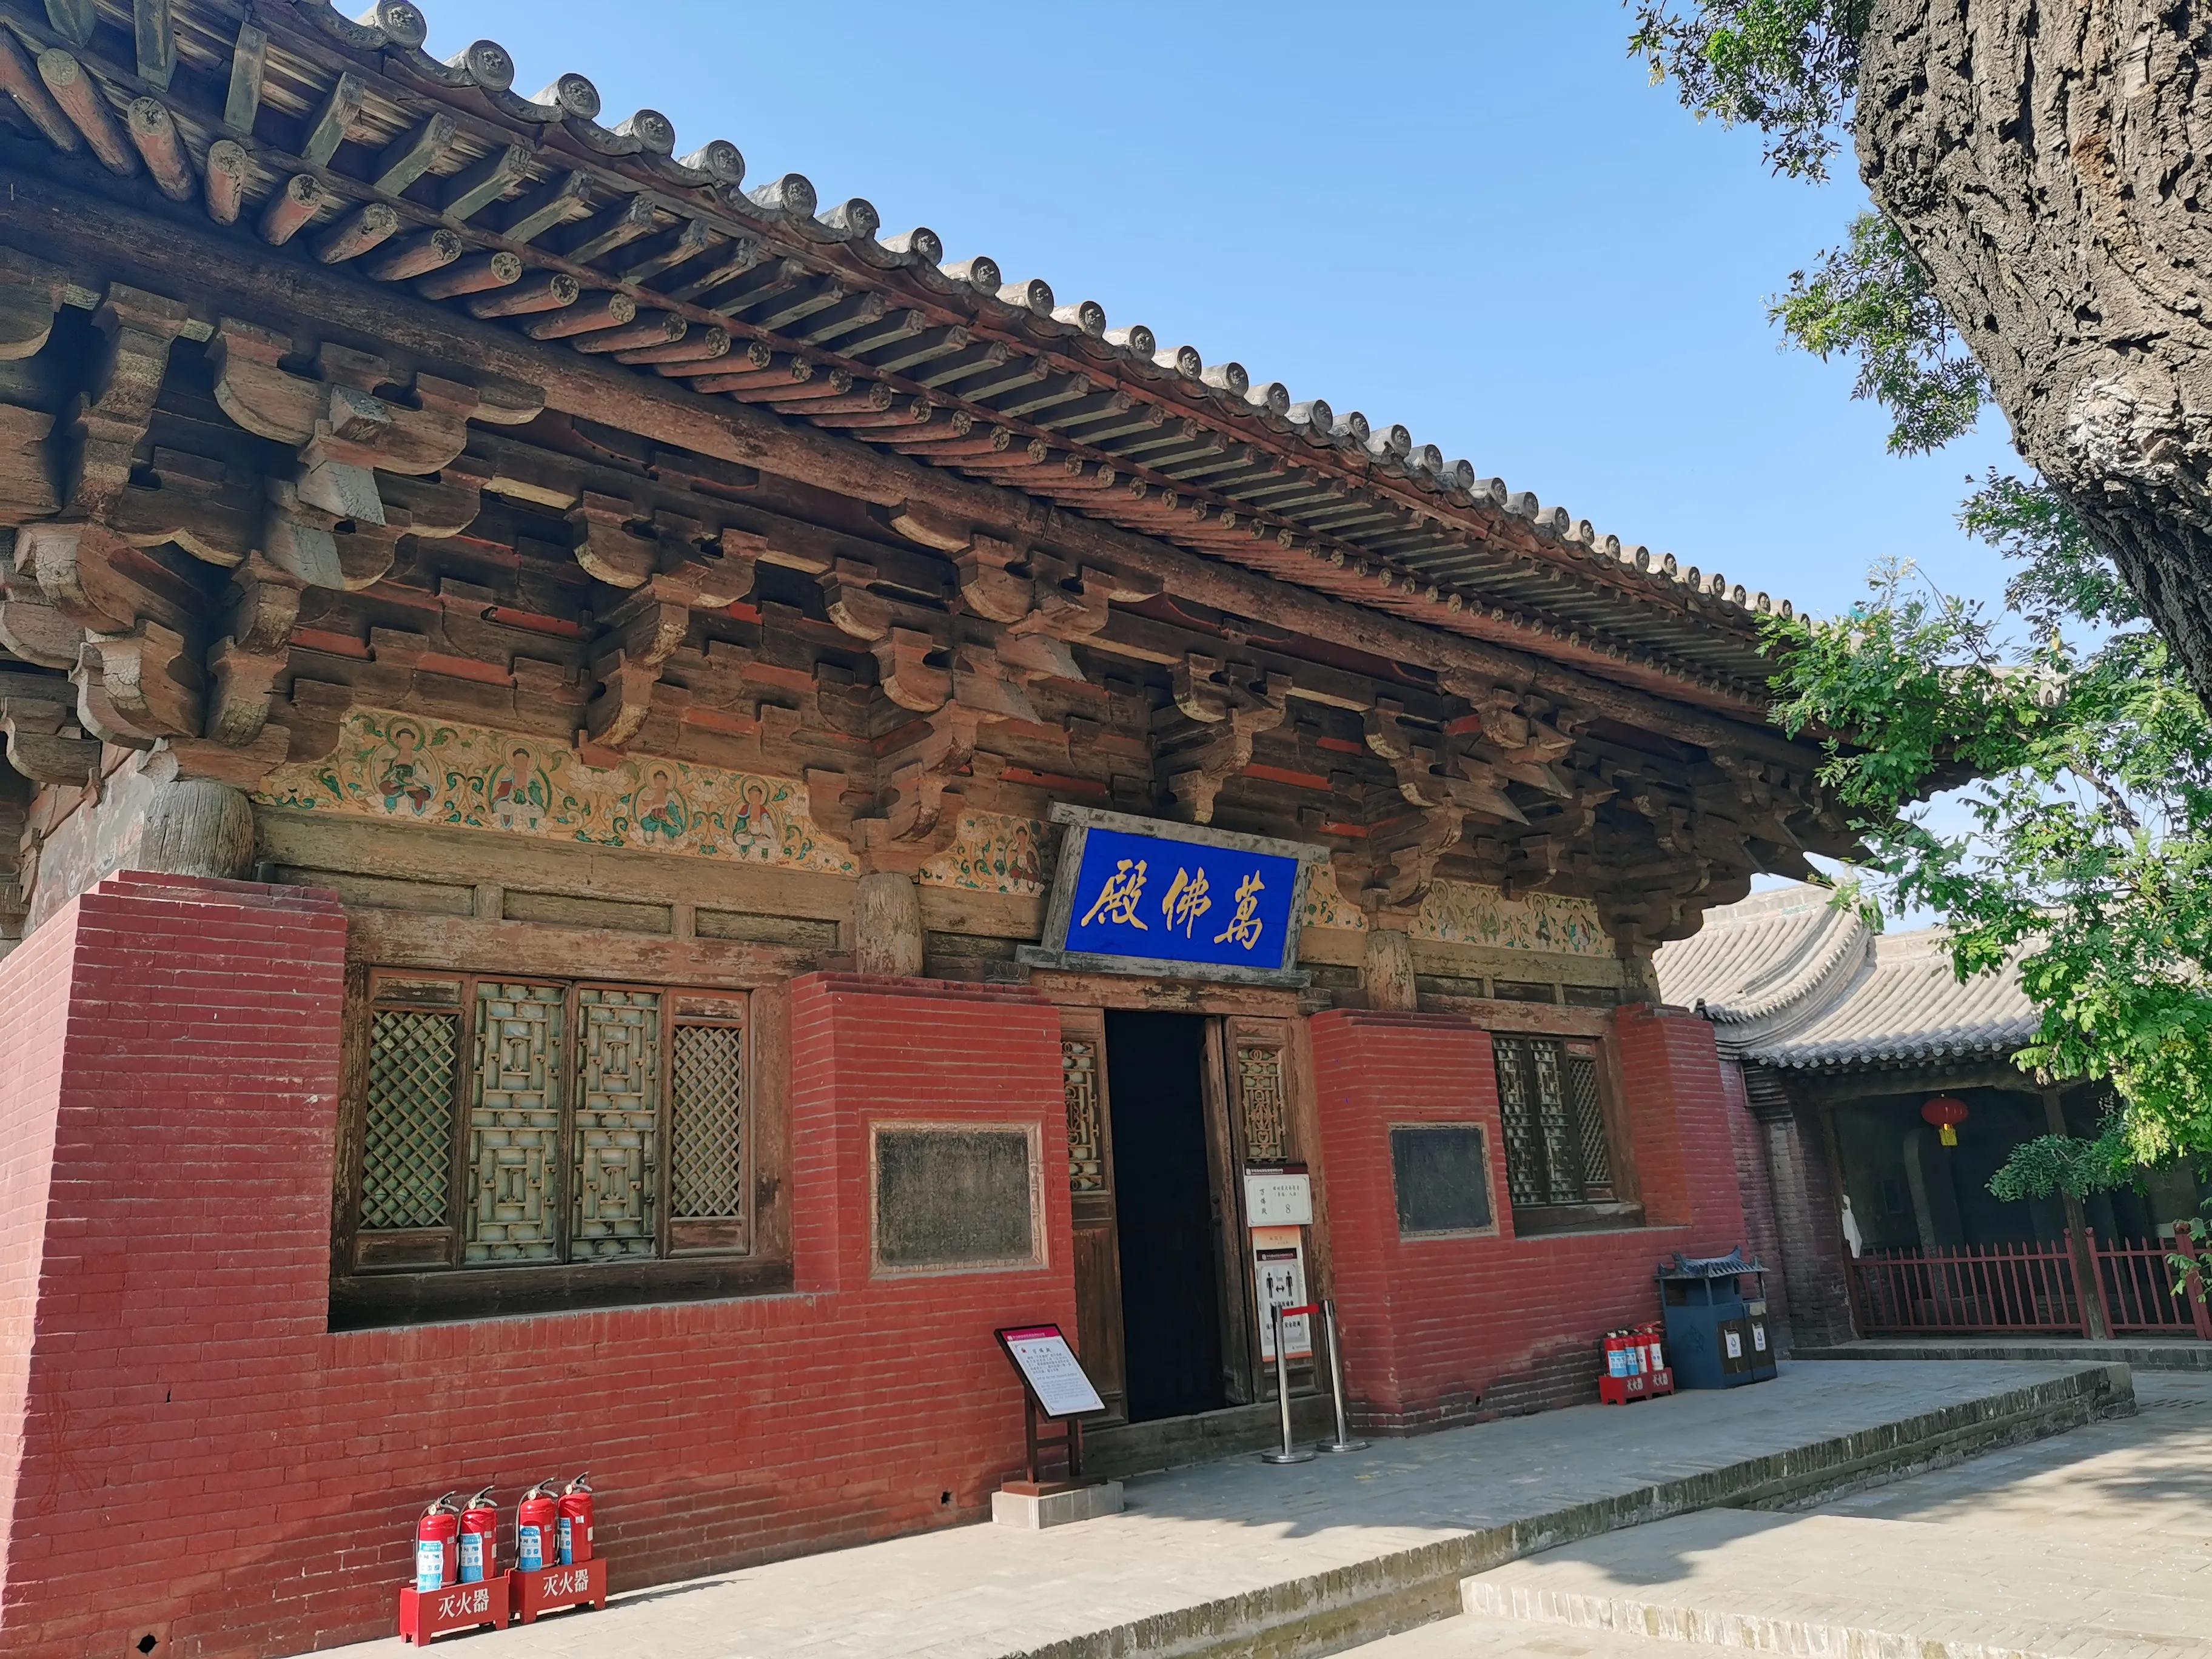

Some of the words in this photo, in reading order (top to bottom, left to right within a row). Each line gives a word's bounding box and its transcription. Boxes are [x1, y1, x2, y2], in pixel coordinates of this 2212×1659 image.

[1081, 858, 1265, 950] 萬佛殿
[1285, 1203, 1291, 1214] 8
[543, 1568, 589, 1599] 灭火器
[437, 1588, 489, 1621] 灭火器
